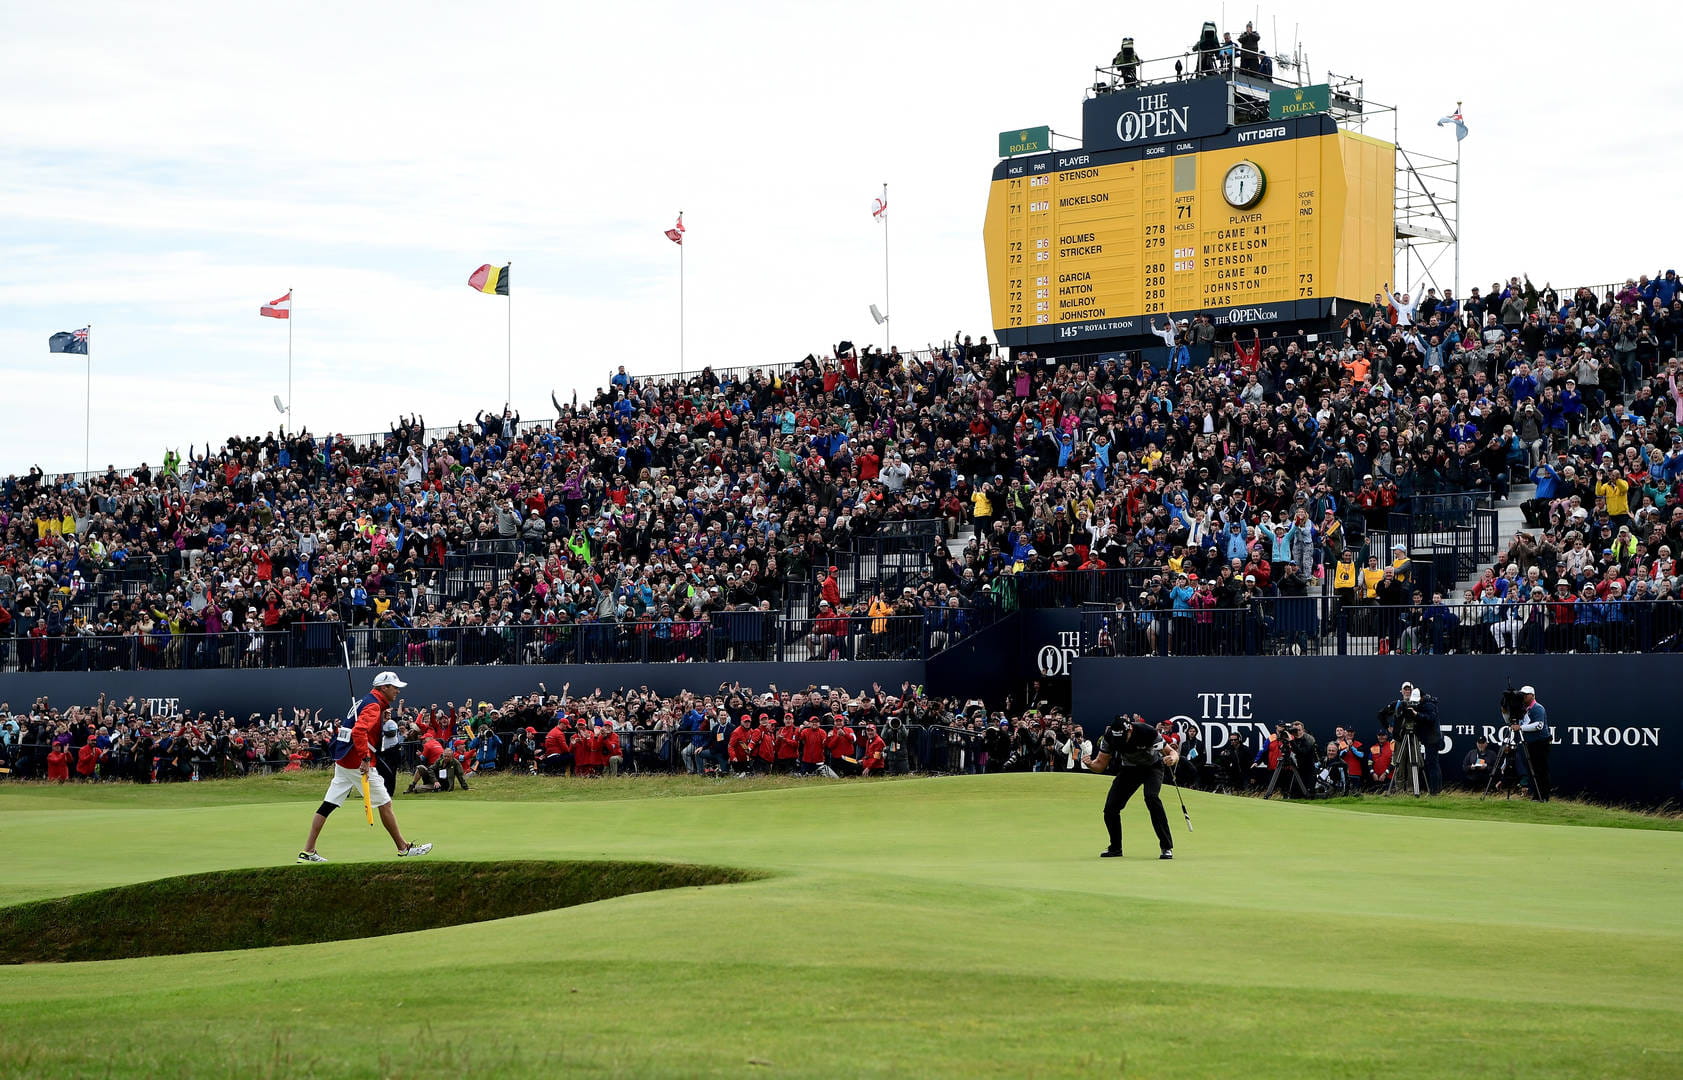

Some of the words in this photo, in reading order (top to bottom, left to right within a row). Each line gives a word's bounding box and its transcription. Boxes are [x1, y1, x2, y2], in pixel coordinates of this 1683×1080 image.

[1137, 93, 1168, 112] THE
[1281, 101, 1316, 114] ROLEX
[1116, 106, 1190, 142] OPEN
[1238, 130, 1258, 142] NTT
[1009, 142, 1038, 153] ROLEX
[1146, 147, 1165, 155] SCORE
[1033, 163, 1046, 171] PAR
[1059, 155, 1090, 167] PLAYER
[1009, 166, 1023, 175] HOLE
[1010, 180, 1021, 189] 71
[1059, 169, 1099, 182] STENSON
[1174, 195, 1195, 204] AFTER
[1298, 191, 1315, 199] SCORE
[1010, 205, 1021, 214] 71
[1059, 193, 1109, 208] MICKELSON
[1177, 205, 1192, 219] 71
[1229, 213, 1263, 225] PLAYER
[1299, 208, 1313, 216] RND
[1174, 223, 1195, 231] HOLES
[1218, 228, 1246, 240] GAME
[1254, 225, 1267, 235] 41
[1010, 242, 1022, 251] 72
[1060, 233, 1095, 245] HOLMES
[1146, 224, 1165, 236] 278
[1010, 255, 1022, 264] 72
[1060, 245, 1102, 258] STRICKER
[1146, 237, 1165, 249] 279
[1203, 238, 1268, 255] MICKELSON
[1204, 253, 1253, 267] STENSON
[1010, 280, 1022, 288] 72
[1059, 272, 1091, 283] GARCIA
[1146, 263, 1165, 274] 280
[1218, 268, 1246, 279] GAME
[1254, 265, 1267, 275] 40
[1010, 292, 1022, 301] 72
[1059, 284, 1093, 296] HATTON
[1146, 276, 1165, 287] 280
[1204, 279, 1260, 294] JOHNSTON
[1299, 273, 1313, 283] 73
[1010, 304, 1022, 313] 72
[1059, 297, 1096, 308] McILROY
[1146, 289, 1165, 300] 280
[1204, 295, 1231, 307] HAAS
[1299, 287, 1313, 297] 75
[1010, 317, 1022, 326] 72
[1060, 308, 1105, 321] JOHNSTON
[1146, 302, 1164, 313] 281
[1084, 323, 1107, 332] ROYAL
[1108, 321, 1133, 329] TROON
[1058, 631, 1080, 647] TH
[1037, 645, 1080, 676] OP
[147, 698, 180, 718] THE
[1197, 693, 1253, 719] THE
[1482, 725, 1562, 746] ROL
[1567, 725, 1661, 747] TROON
